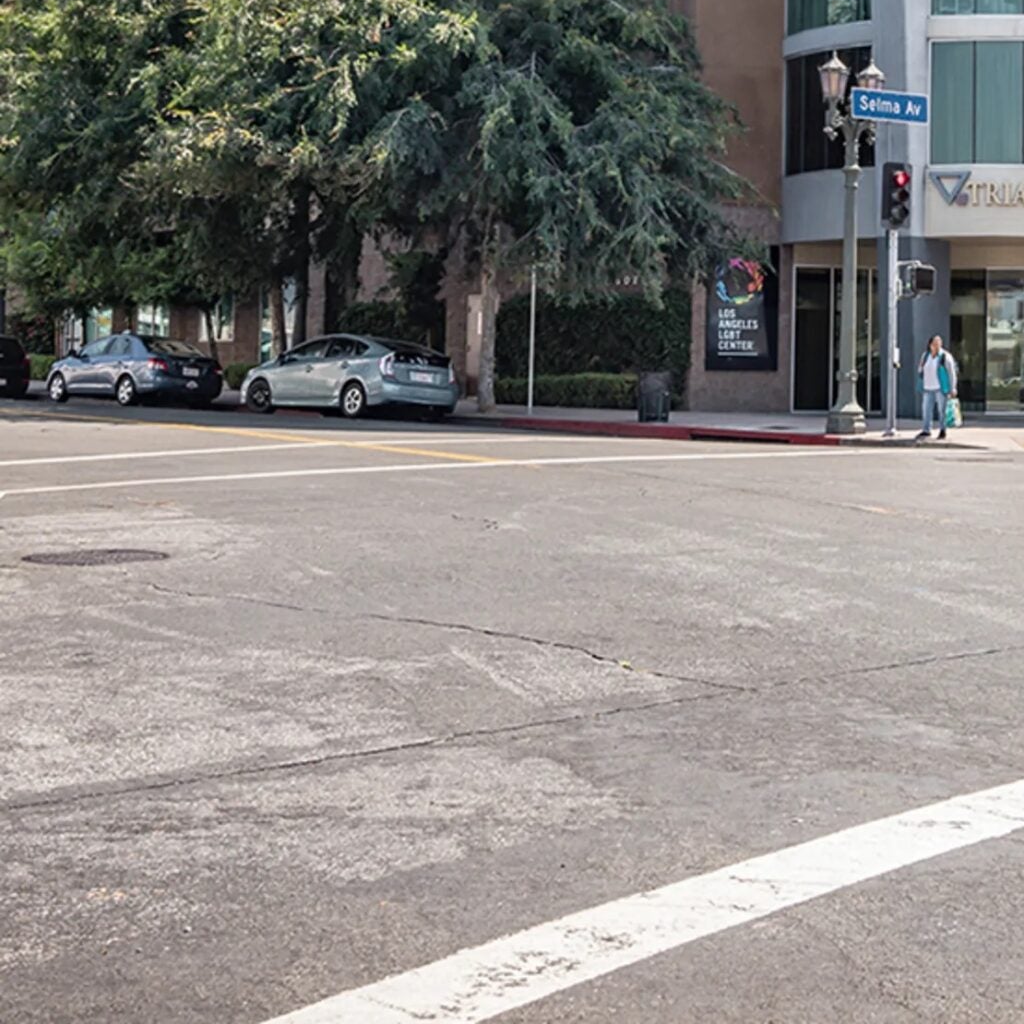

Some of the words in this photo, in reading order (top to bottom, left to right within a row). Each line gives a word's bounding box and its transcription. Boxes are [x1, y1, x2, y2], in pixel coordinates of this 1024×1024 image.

[859, 94, 900, 114] Selma
[905, 100, 922, 116] Av
[718, 308, 736, 318] LOS
[718, 319, 758, 330] ANGELES
[718, 330, 741, 340] LGBT
[718, 340, 754, 351] CENTER
